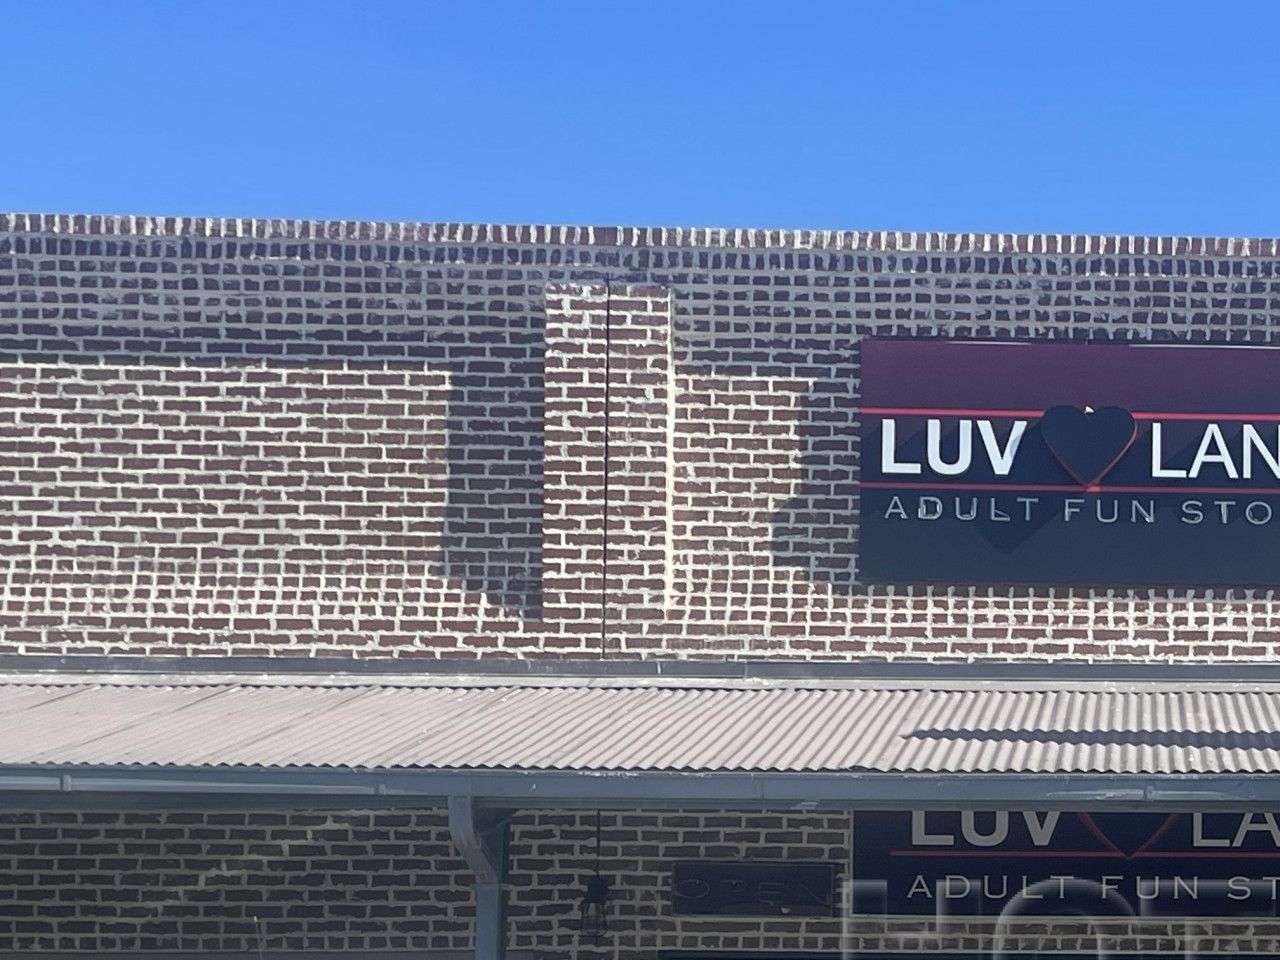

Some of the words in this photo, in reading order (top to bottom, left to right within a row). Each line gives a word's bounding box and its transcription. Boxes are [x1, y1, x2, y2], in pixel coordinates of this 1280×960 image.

[881, 418, 1027, 476] LUV
[884, 495, 1038, 521] ADULT
[1064, 499, 1155, 523] FUN
[912, 811, 1061, 847] LUV
[906, 874, 1075, 898] ADULT
[1101, 875, 1198, 899] FUN
